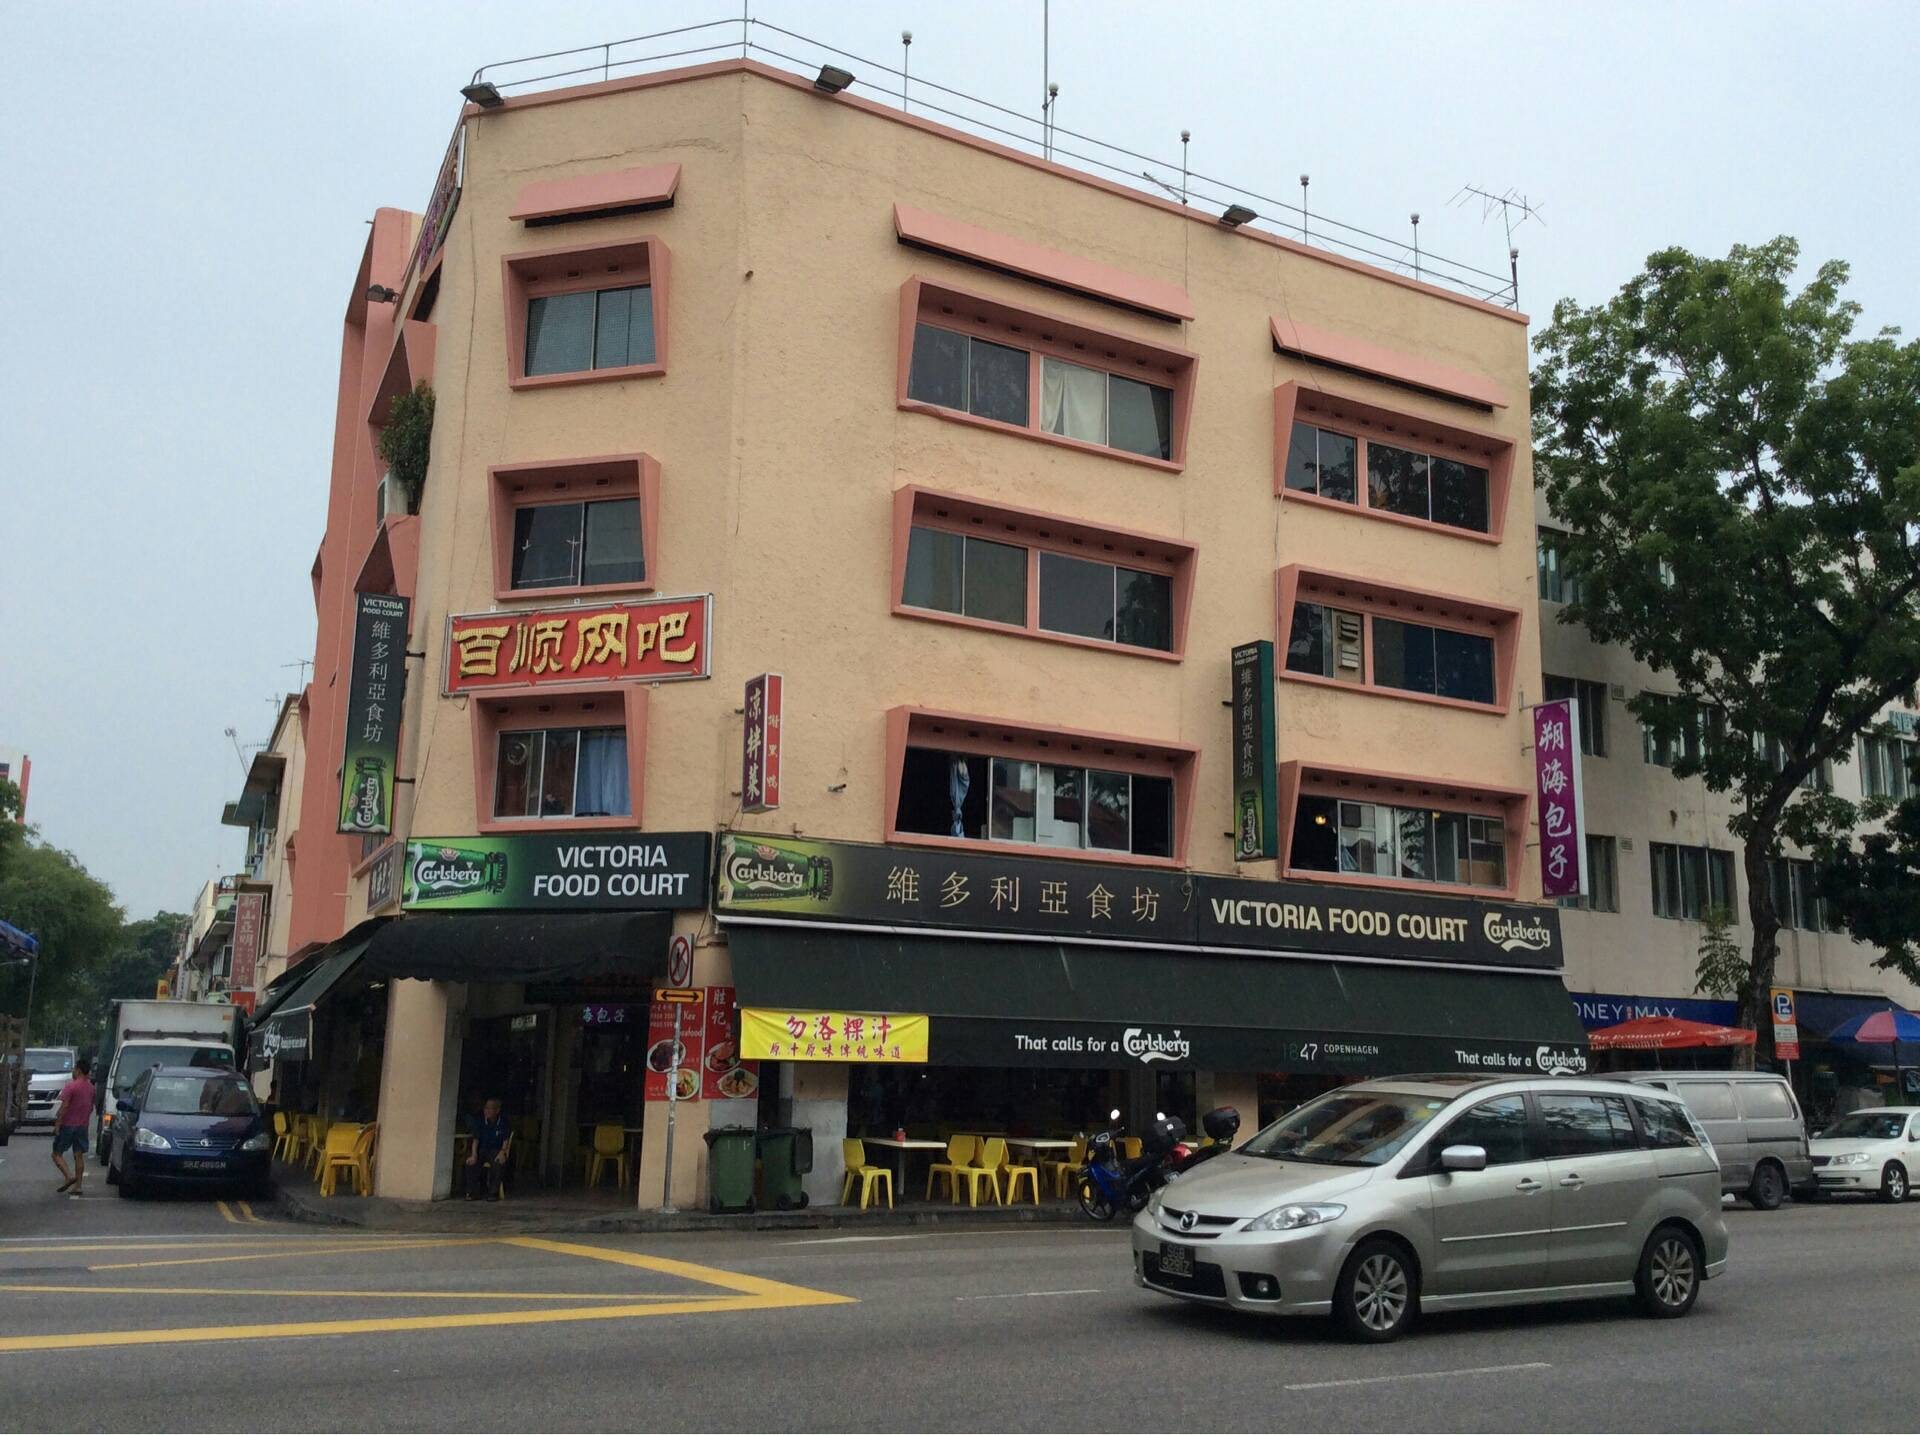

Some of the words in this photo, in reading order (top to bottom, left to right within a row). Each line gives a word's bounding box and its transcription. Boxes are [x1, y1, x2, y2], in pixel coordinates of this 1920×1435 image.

[363, 598, 403, 610] VICTORIA
[382, 609, 404, 617] COURT
[452, 612, 697, 678] 百顺网吧
[363, 620, 391, 743] 維多利亞食坊
[356, 777, 378, 828] Carlsberg
[1539, 720, 1572, 879] 朔海包子
[557, 845, 668, 868] VICTORIA
[418, 861, 480, 885] Carlsberg
[533, 874, 600, 897] FOOD
[607, 873, 689, 896] COURT
[730, 857, 803, 888] Carlsberg
[887, 866, 1160, 922] 維多利亞食坊
[1211, 898, 1322, 931] VICTORIA
[1328, 908, 1390, 936] FOOD
[1397, 914, 1468, 942] COURT
[1483, 912, 1551, 949] Carlsberg
[1635, 1005, 1675, 1019] MAX
[786, 1015, 891, 1044] 勿洛粿汁
[1015, 1034, 1048, 1051] That
[1052, 1036, 1083, 1052] calls
[1087, 1037, 1106, 1052] for
[1111, 1040, 1119, 1052] a
[1123, 1028, 1190, 1058] Carlsberg
[1323, 1043, 1379, 1055] COPENHAGEN
[1455, 1050, 1479, 1065] That
[1482, 1052, 1505, 1066] calls
[1508, 1053, 1521, 1066] for
[1525, 1057, 1532, 1067] a
[1536, 1046, 1587, 1072] Carlsberg
